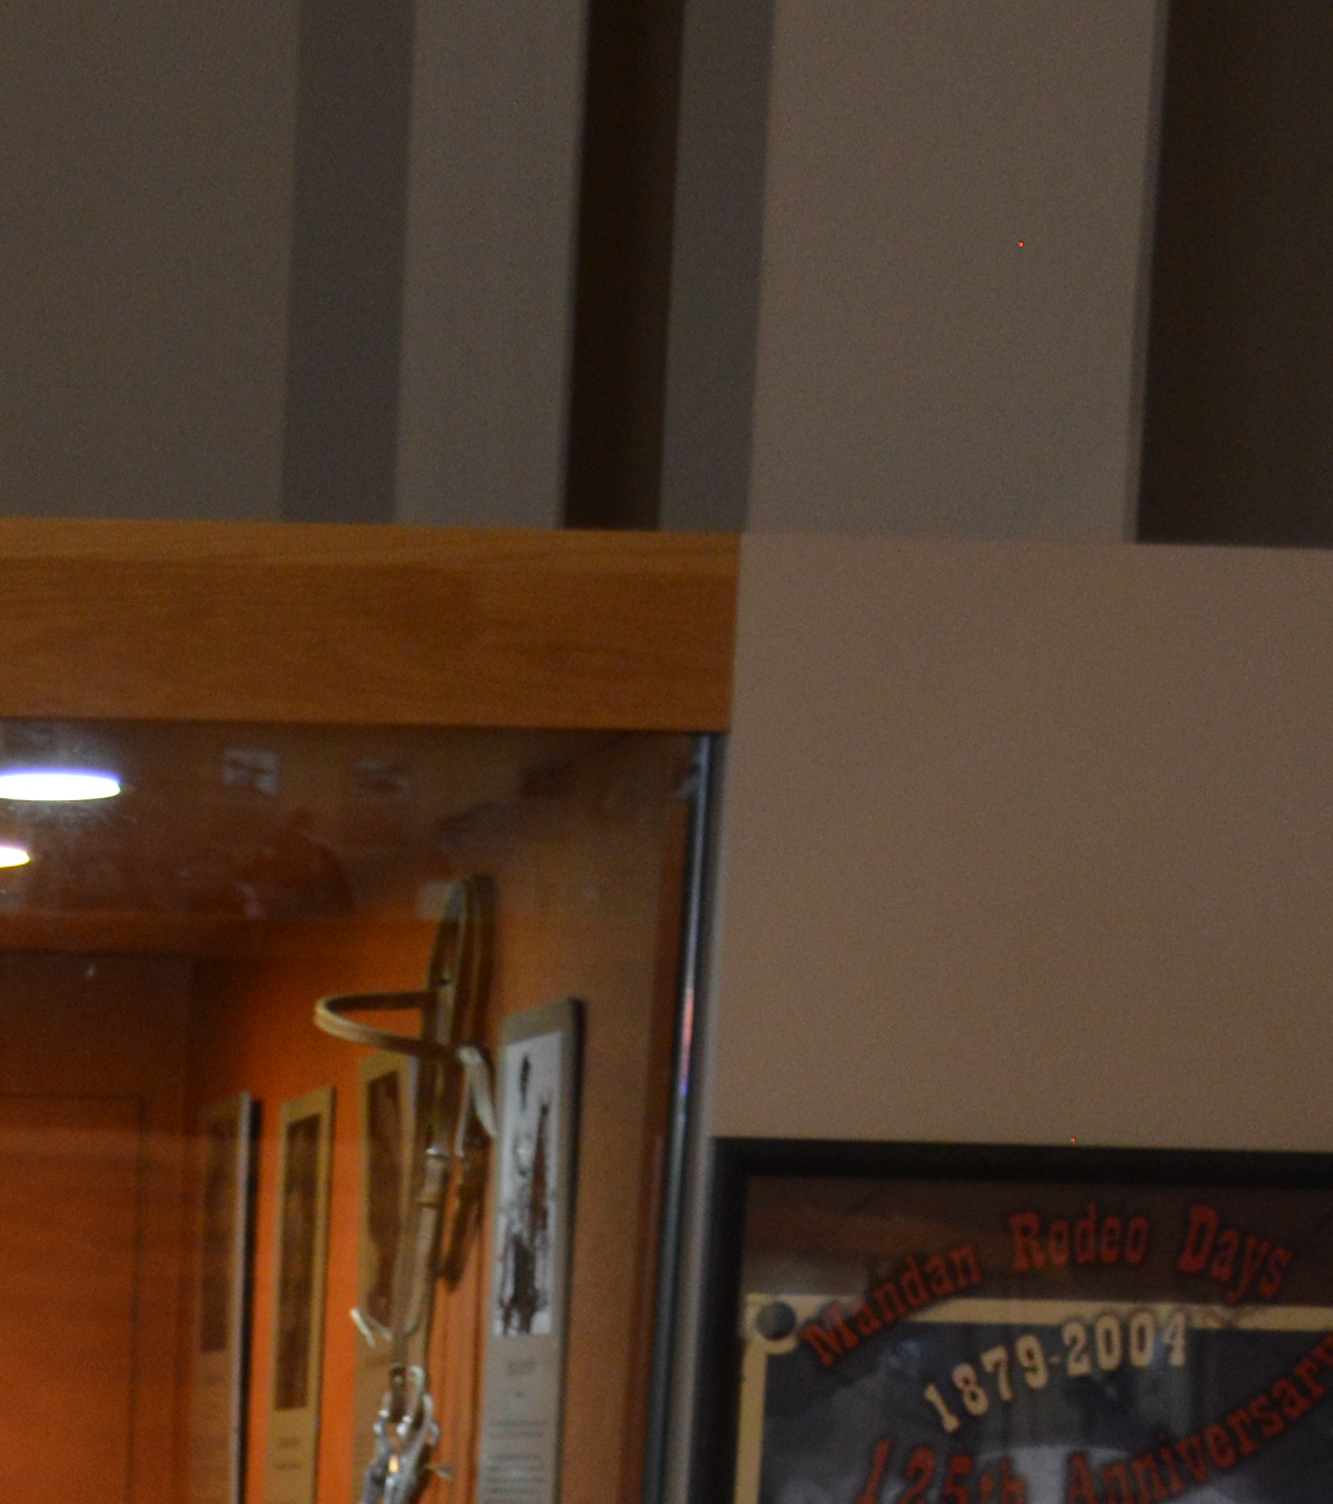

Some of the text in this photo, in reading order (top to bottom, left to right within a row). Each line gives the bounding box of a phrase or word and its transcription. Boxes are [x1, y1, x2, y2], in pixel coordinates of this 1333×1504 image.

[798, 1202, 1292, 1366] Mandan Rodeo Days
[923, 1310, 1188, 1434] 1879-2004
